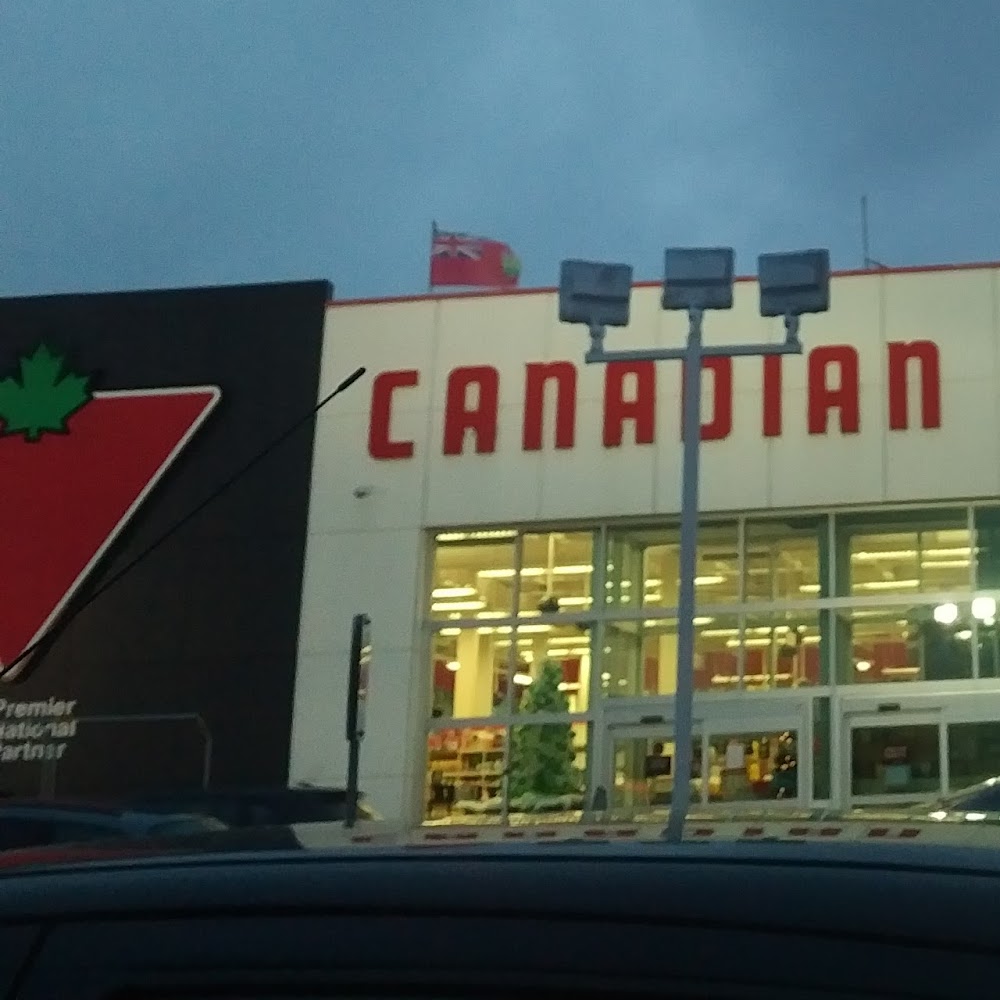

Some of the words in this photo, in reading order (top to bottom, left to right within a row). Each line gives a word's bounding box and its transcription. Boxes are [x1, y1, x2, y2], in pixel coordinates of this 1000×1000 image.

[367, 339, 942, 460] CANADIAN
[0, 719, 77, 739] ational
[0, 741, 67, 762] artner
